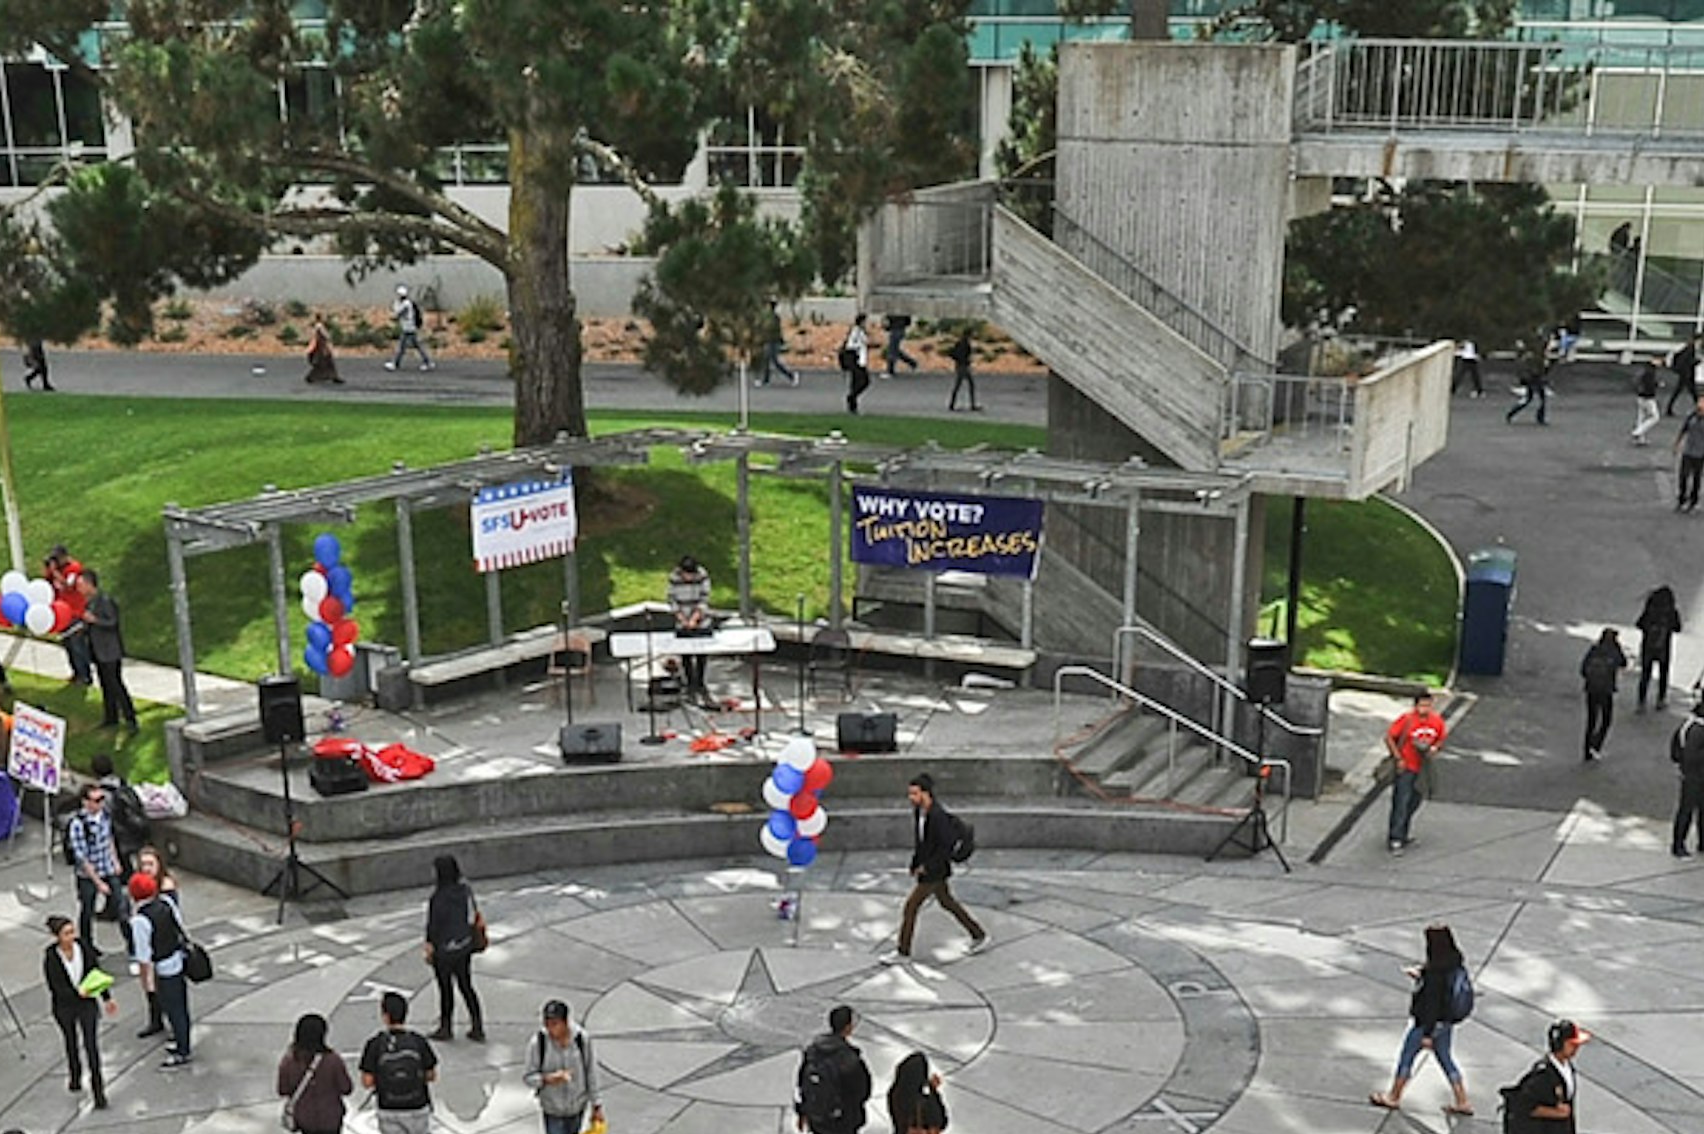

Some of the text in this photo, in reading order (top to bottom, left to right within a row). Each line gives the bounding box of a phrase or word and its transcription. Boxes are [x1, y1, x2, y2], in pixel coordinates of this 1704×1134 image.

[856, 495, 985, 524] WHY VOTE?
[906, 531, 1037, 564] INCREASES
